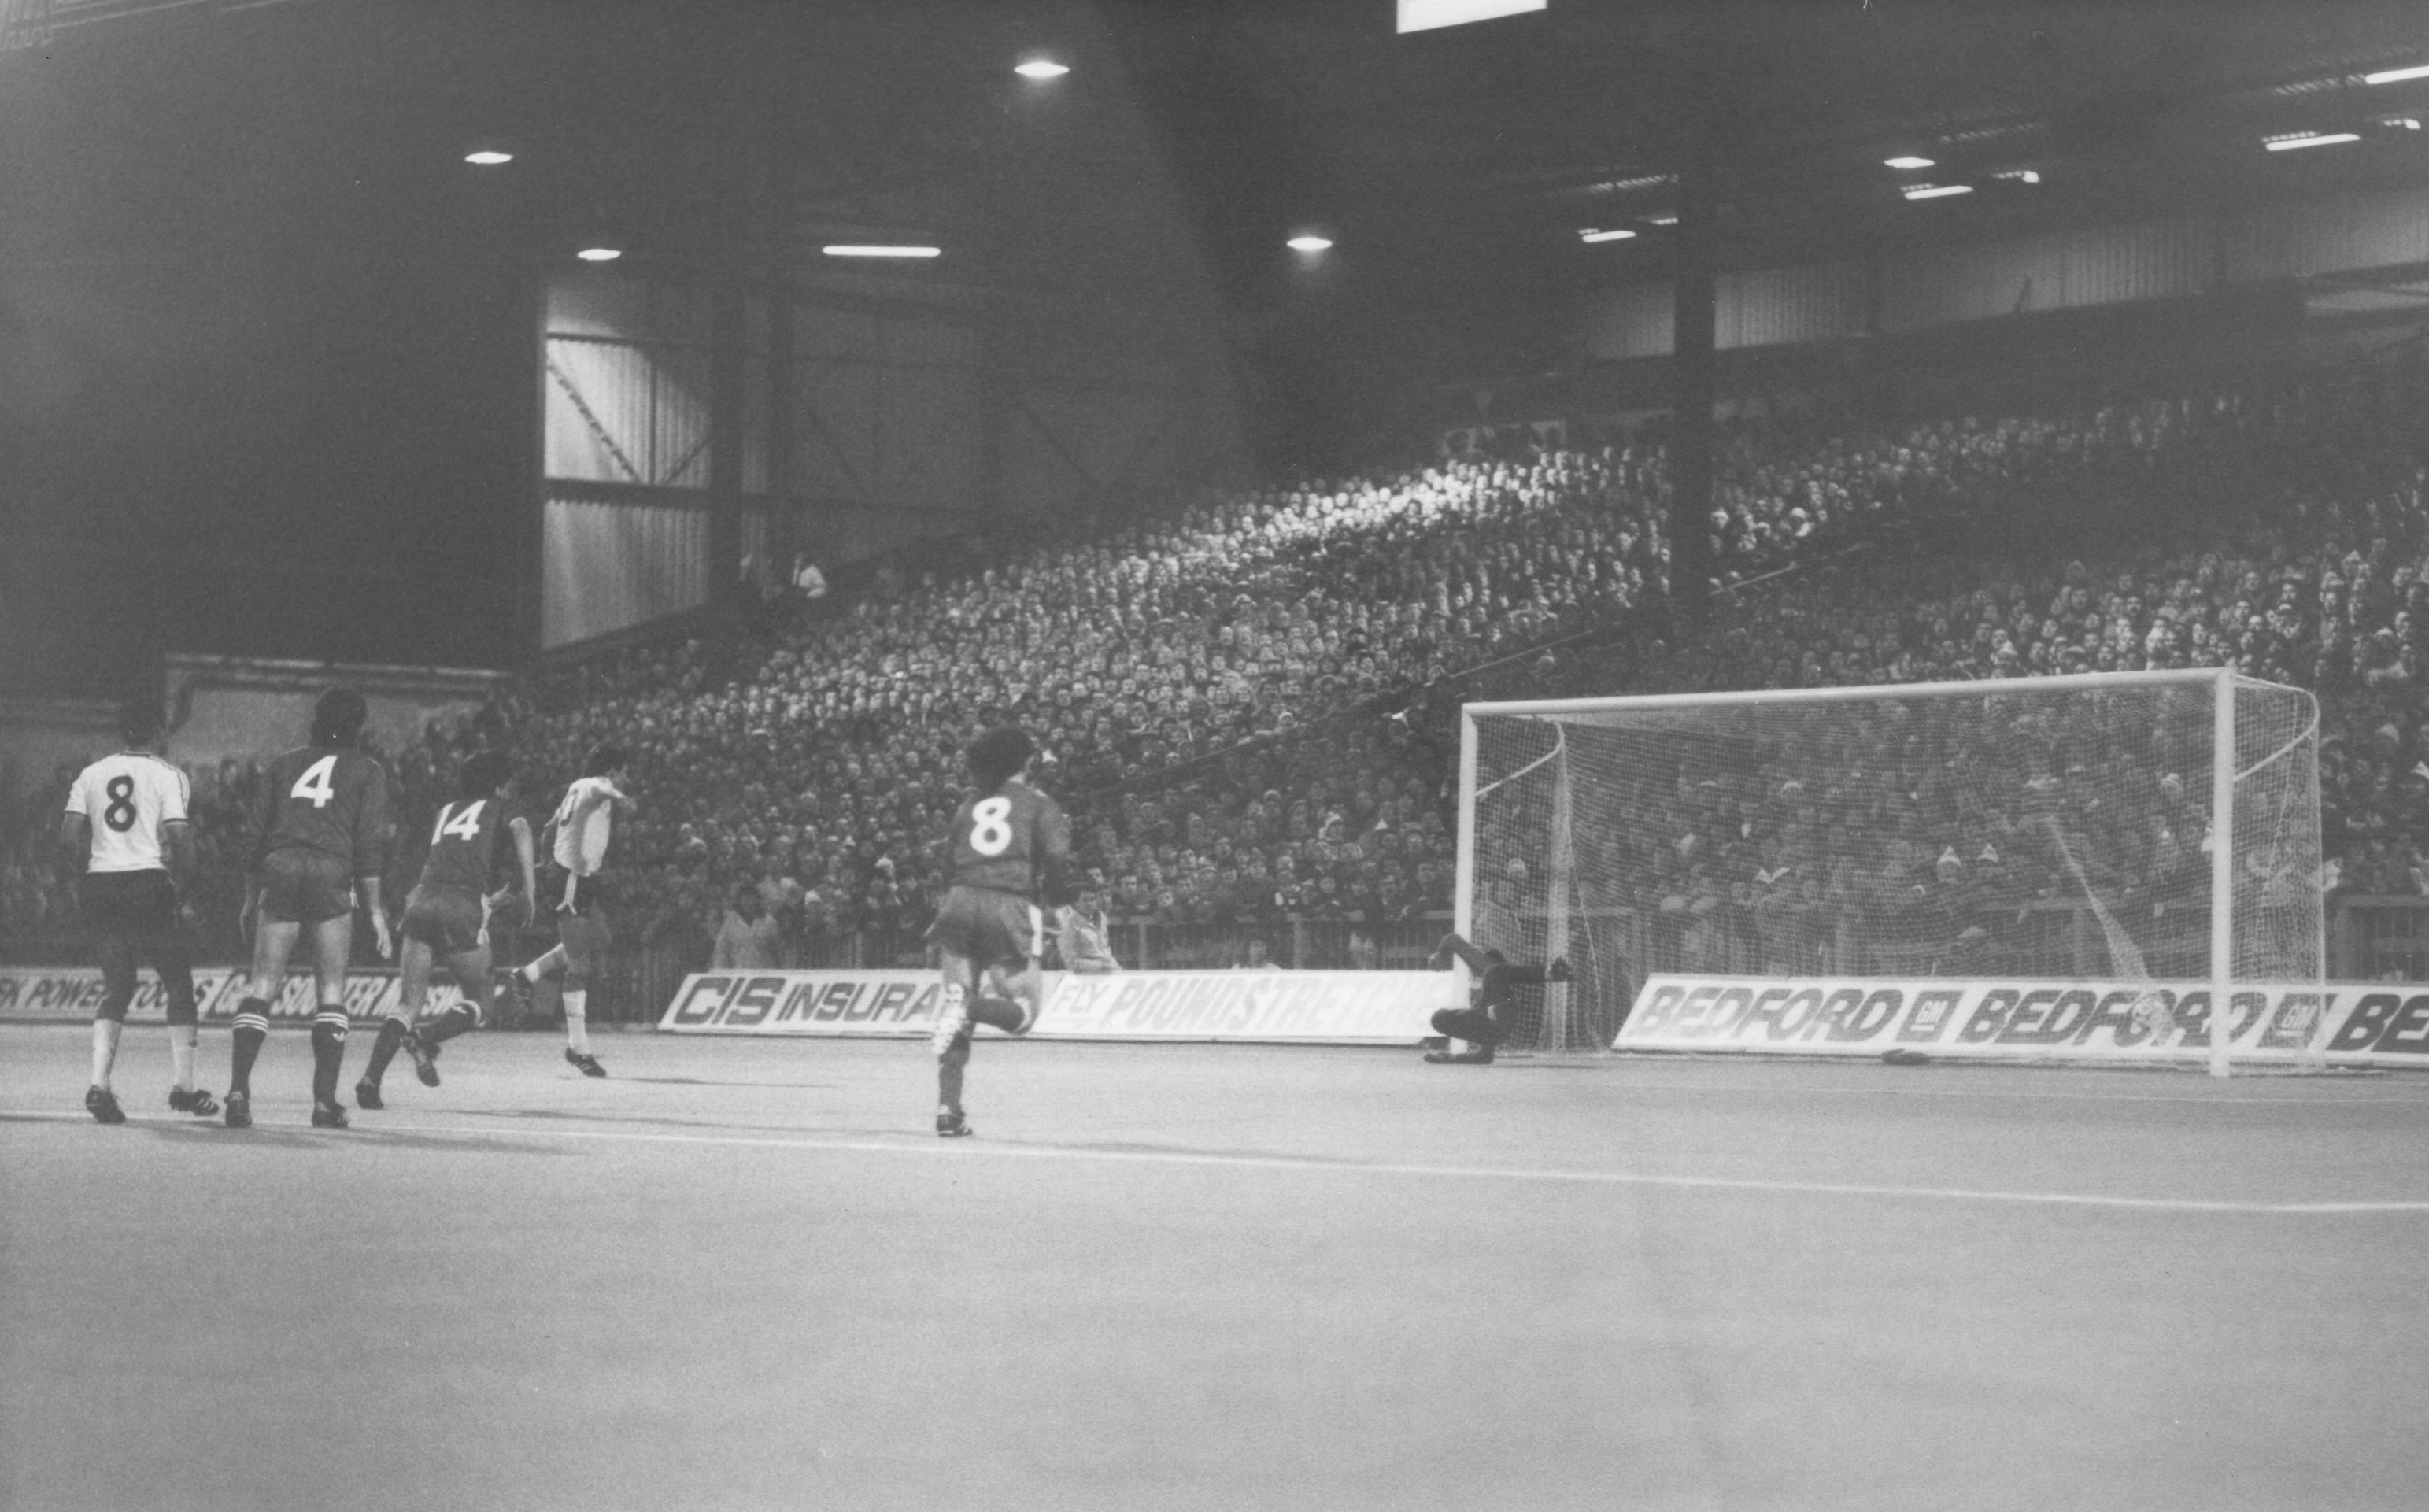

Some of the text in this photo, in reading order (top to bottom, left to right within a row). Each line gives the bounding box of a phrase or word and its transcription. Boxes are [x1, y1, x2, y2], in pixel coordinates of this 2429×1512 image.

[105, 774, 137, 834] 8
[290, 754, 338, 808] 4
[431, 799, 487, 846] 14
[970, 796, 1012, 856] 8
[674, 976, 945, 1026] CIS INSURA
[1052, 977, 1454, 1032] FLY POUNDSTRETCHE
[1626, 985, 1904, 1043] BEDFORD
[1913, 1000, 1950, 1023] GM
